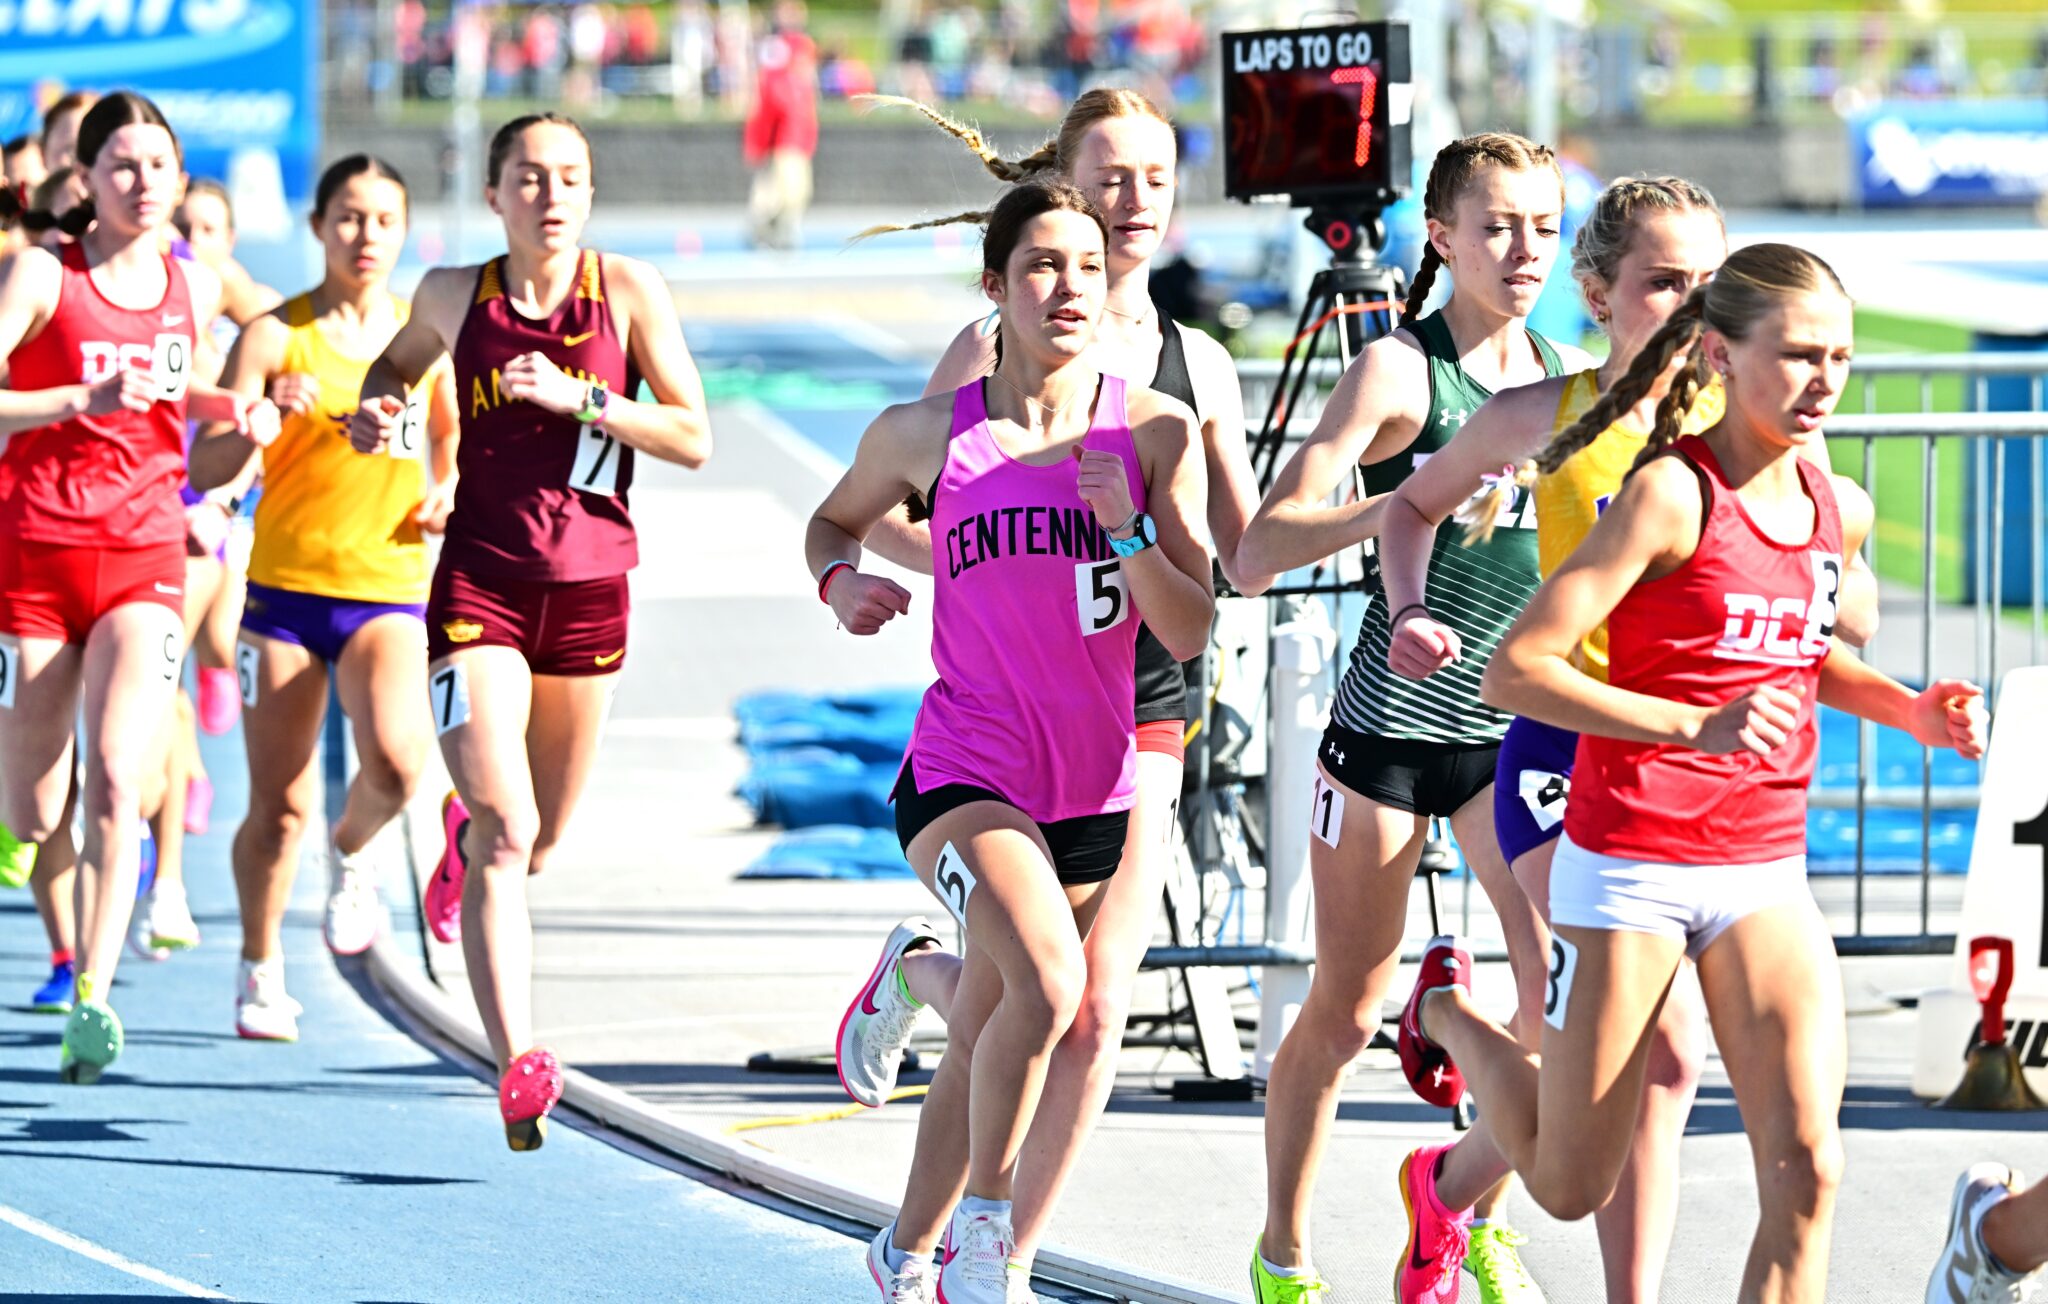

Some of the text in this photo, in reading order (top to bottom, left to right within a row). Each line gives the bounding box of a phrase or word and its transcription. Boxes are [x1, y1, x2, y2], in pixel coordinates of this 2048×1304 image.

[1234, 32, 1373, 73] LAPS TO GO
[1330, 66, 1377, 167] 7
[79, 341, 156, 385] DC
[166, 342, 183, 393] 9
[584, 428, 615, 486] 7
[946, 506, 1118, 580] CENTENNI
[1092, 560, 1122, 630] 5
[1819, 560, 1839, 637] 3
[435, 669, 456, 728] 7
[1312, 776, 1334, 839] 11
[937, 853, 966, 916] 5
